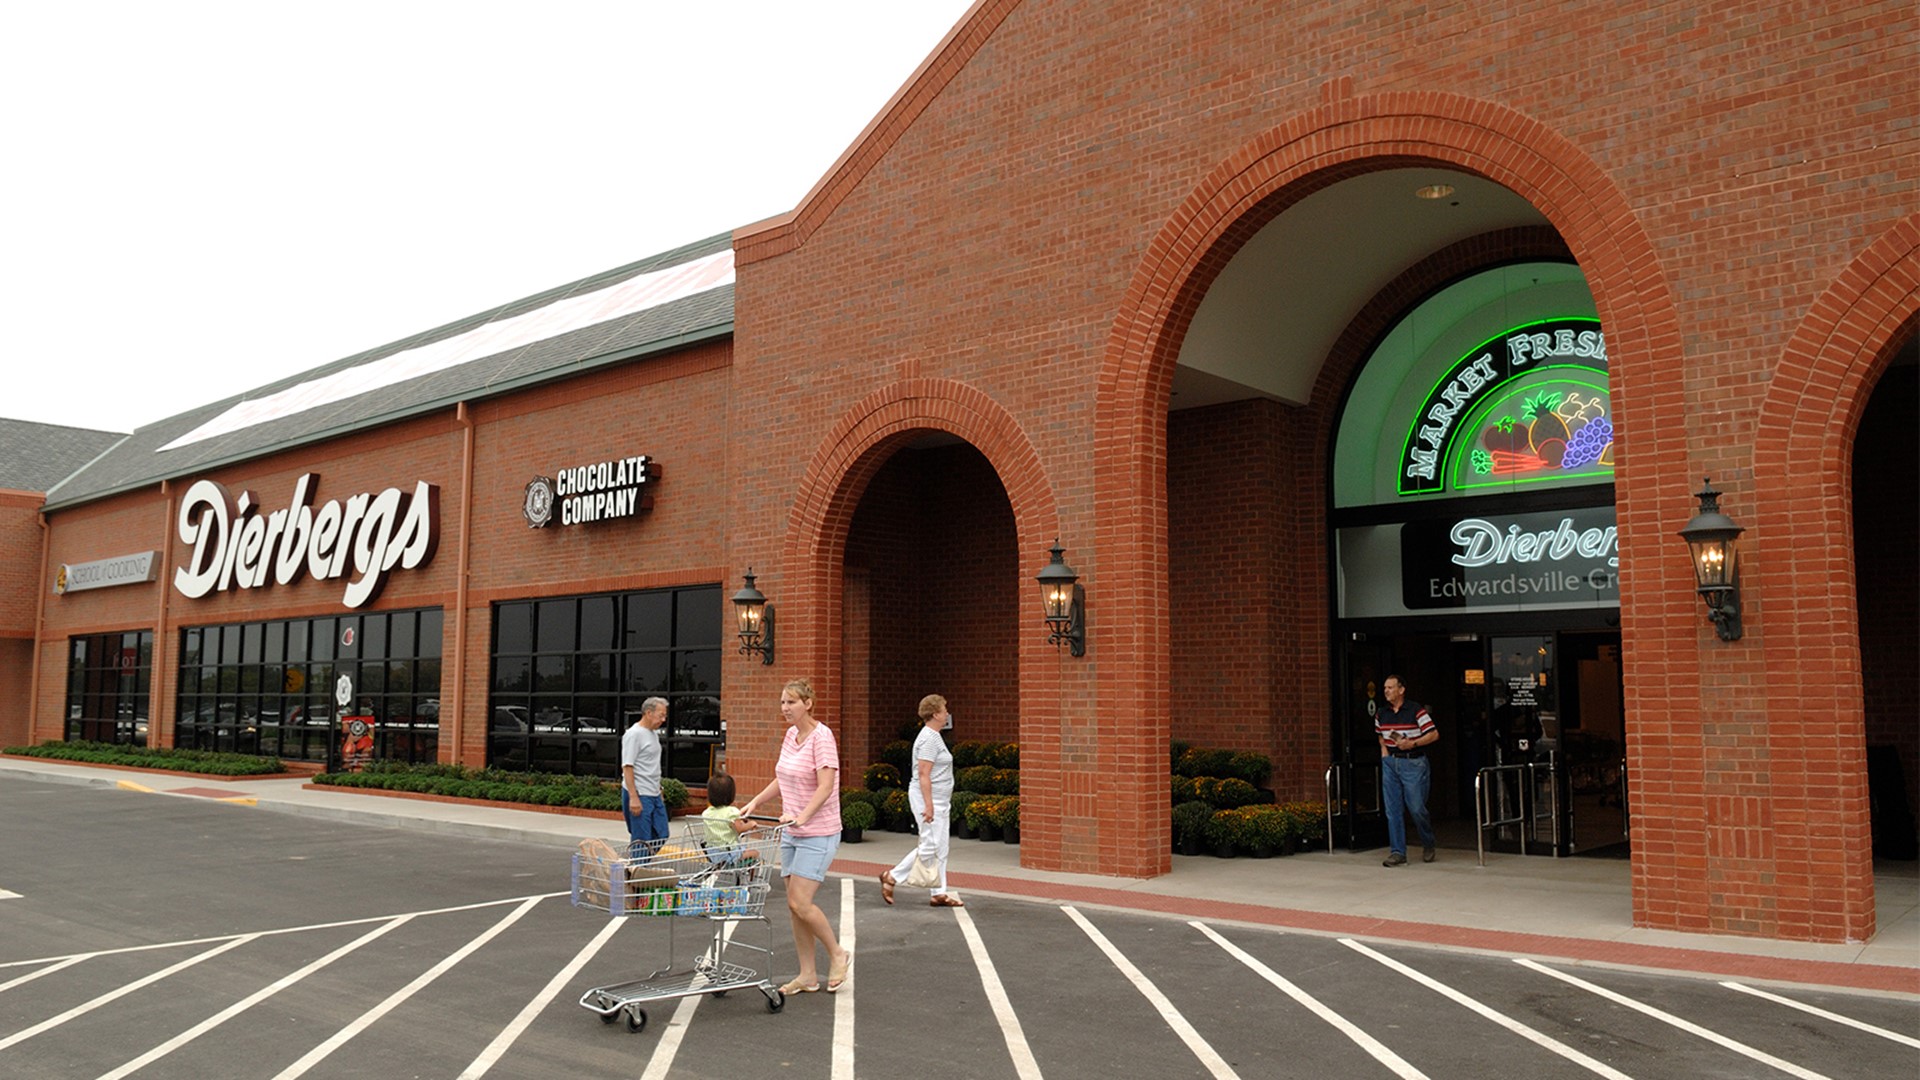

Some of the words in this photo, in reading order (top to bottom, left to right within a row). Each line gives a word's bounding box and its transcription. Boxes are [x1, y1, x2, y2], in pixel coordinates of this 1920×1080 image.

[1407, 354, 1498, 480] MARKET
[557, 455, 646, 496] CHOCOLATE
[561, 487, 638, 526] COMPANY
[174, 473, 431, 609] Dierbergs
[1450, 518, 1619, 567] Dierber
[71, 565, 101, 585] SCHOOL
[107, 557, 147, 580] COOKING
[1430, 571, 1580, 598] Edwardsville
